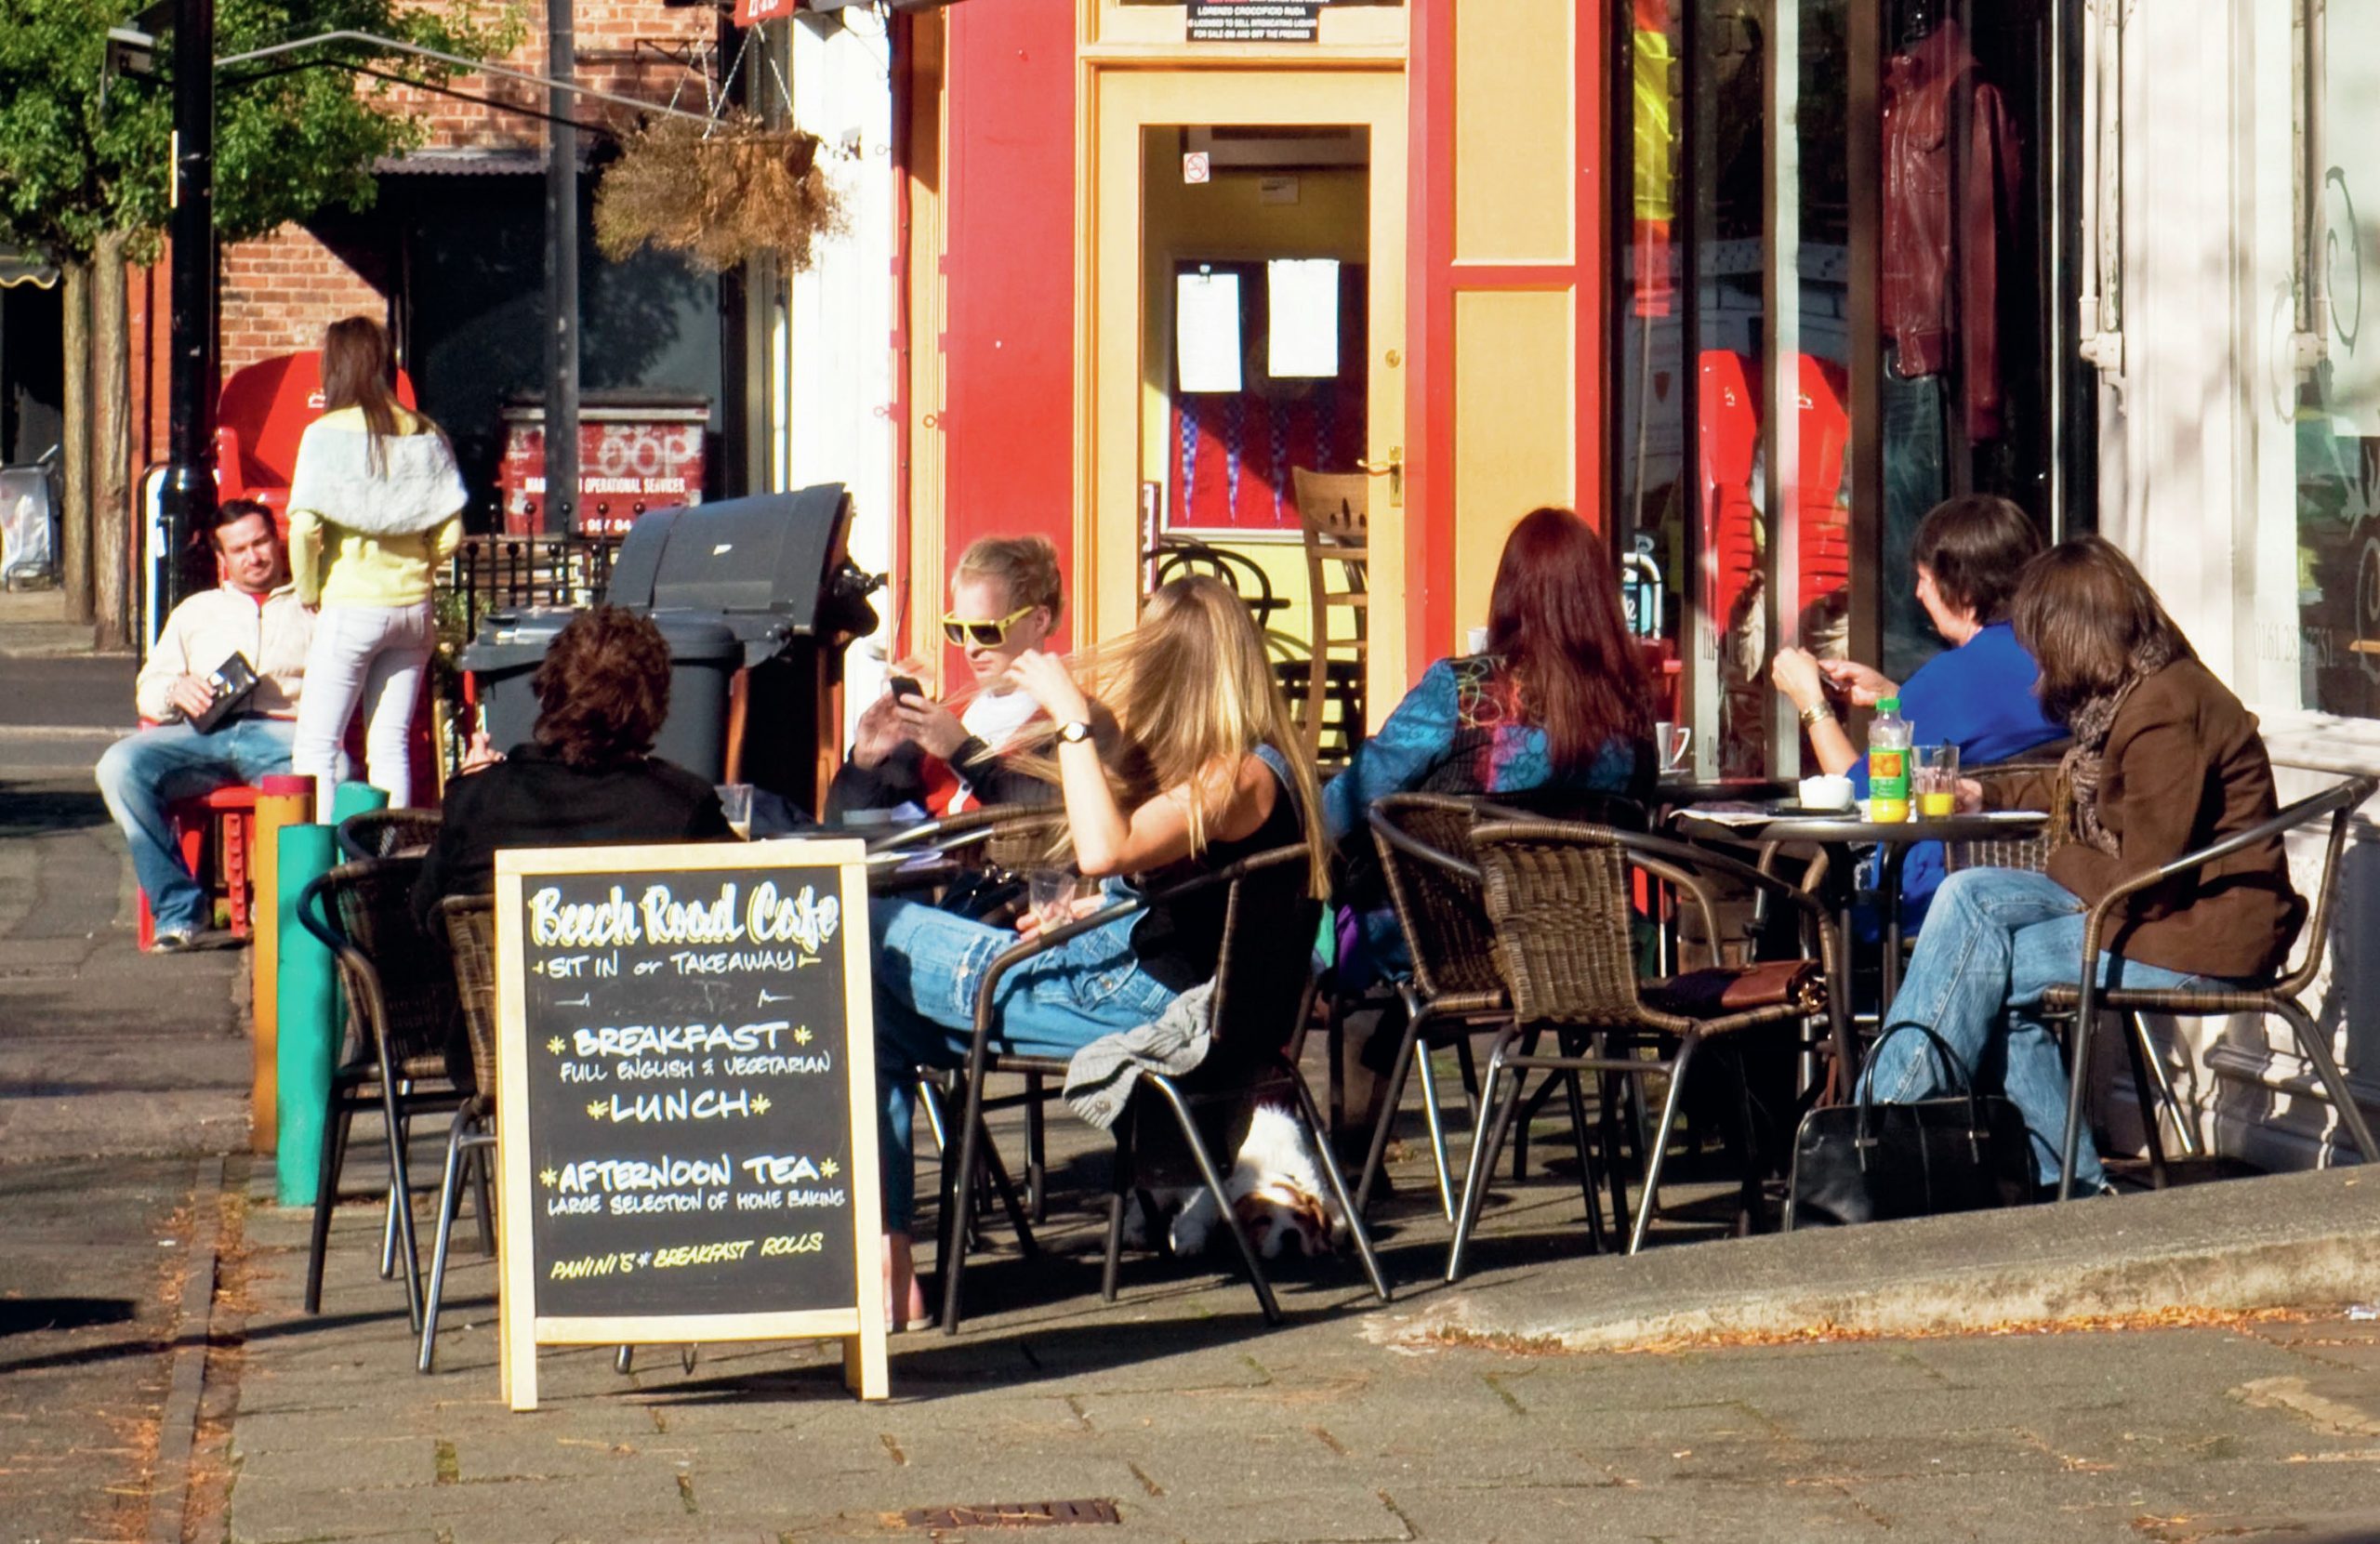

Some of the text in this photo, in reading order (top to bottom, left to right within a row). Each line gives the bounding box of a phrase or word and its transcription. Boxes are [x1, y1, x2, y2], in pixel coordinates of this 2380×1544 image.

[528, 881, 840, 953] Beech Road Cafe
[548, 950, 795, 978] SIT IN or TAKEAWAY
[573, 1022, 789, 1057] BREAKFAST
[560, 1061, 607, 1083] FULL
[617, 1057, 694, 1080] ENGLISH
[723, 1050, 831, 1076] VEGETARIAN
[610, 1089, 750, 1122] LUNCH
[559, 1154, 819, 1194] AFTERNOON TEA
[547, 1188, 846, 1216] LARGE SELECTION OF HOME BAKING
[550, 1233, 824, 1280] PANINI'S BREAKFAST ROLLS
